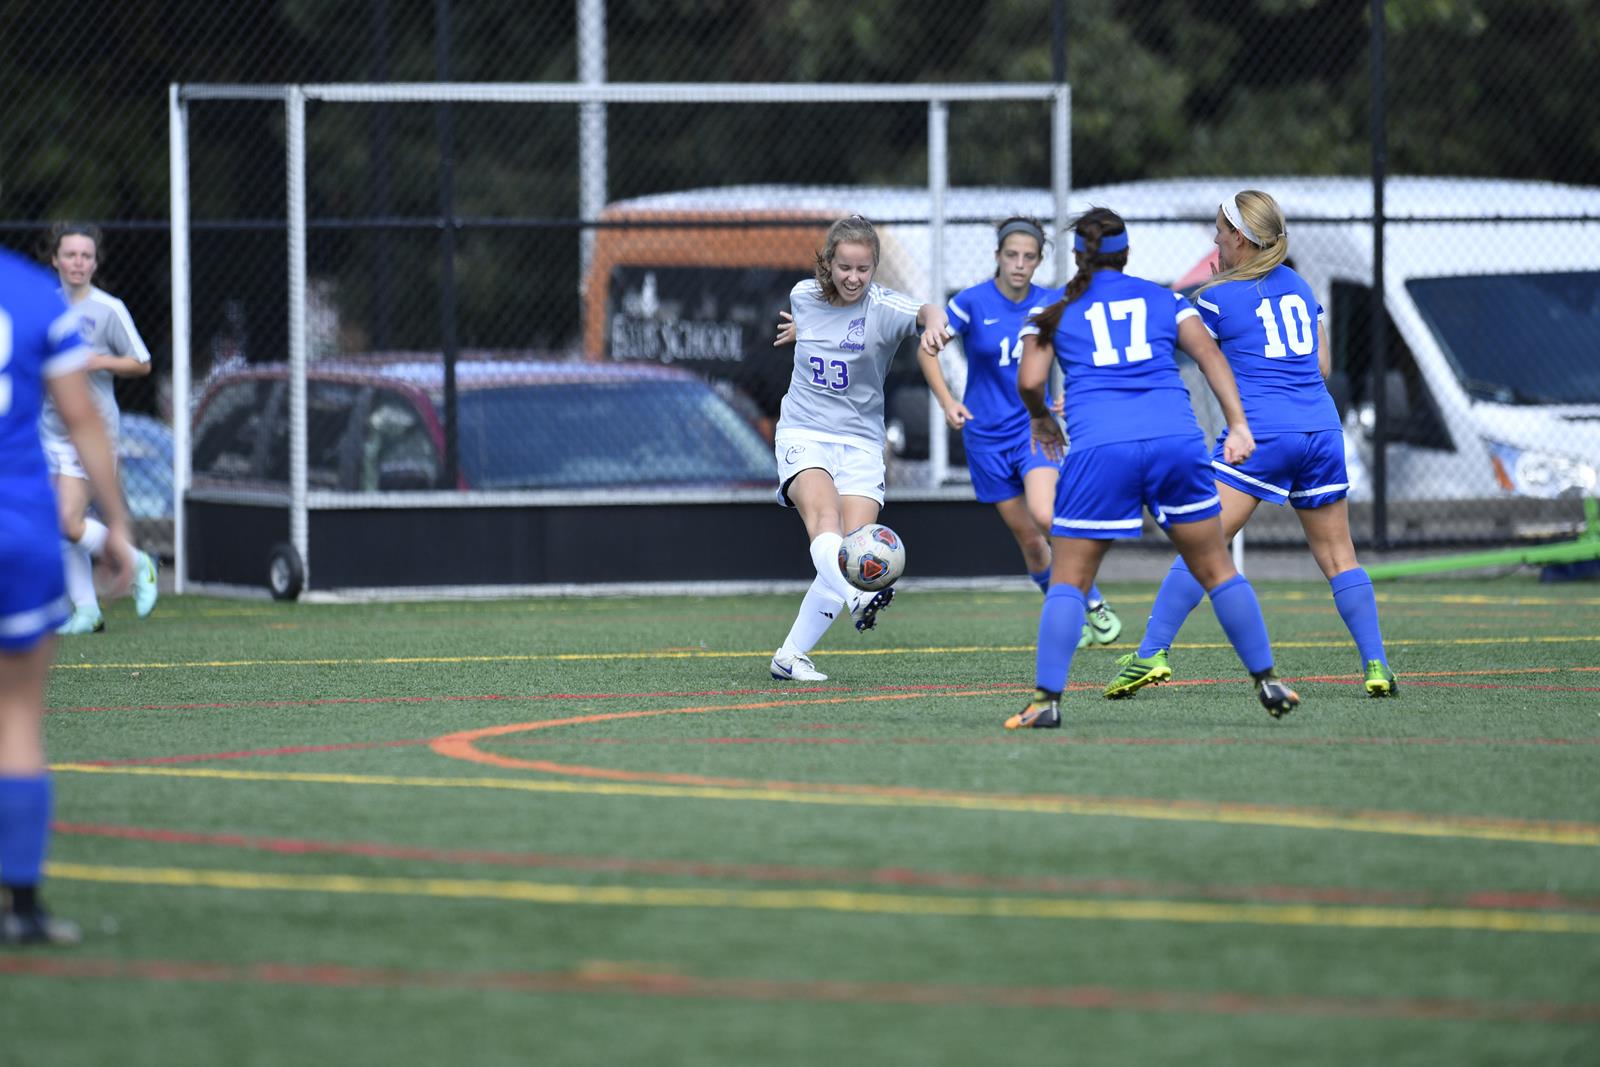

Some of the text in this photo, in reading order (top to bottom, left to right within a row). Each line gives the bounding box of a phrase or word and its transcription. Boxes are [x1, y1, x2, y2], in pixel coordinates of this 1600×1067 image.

[1084, 297, 1153, 367] 17
[1256, 294, 1314, 358] 10
[808, 356, 849, 390] 23
[999, 336, 1025, 367] 14
